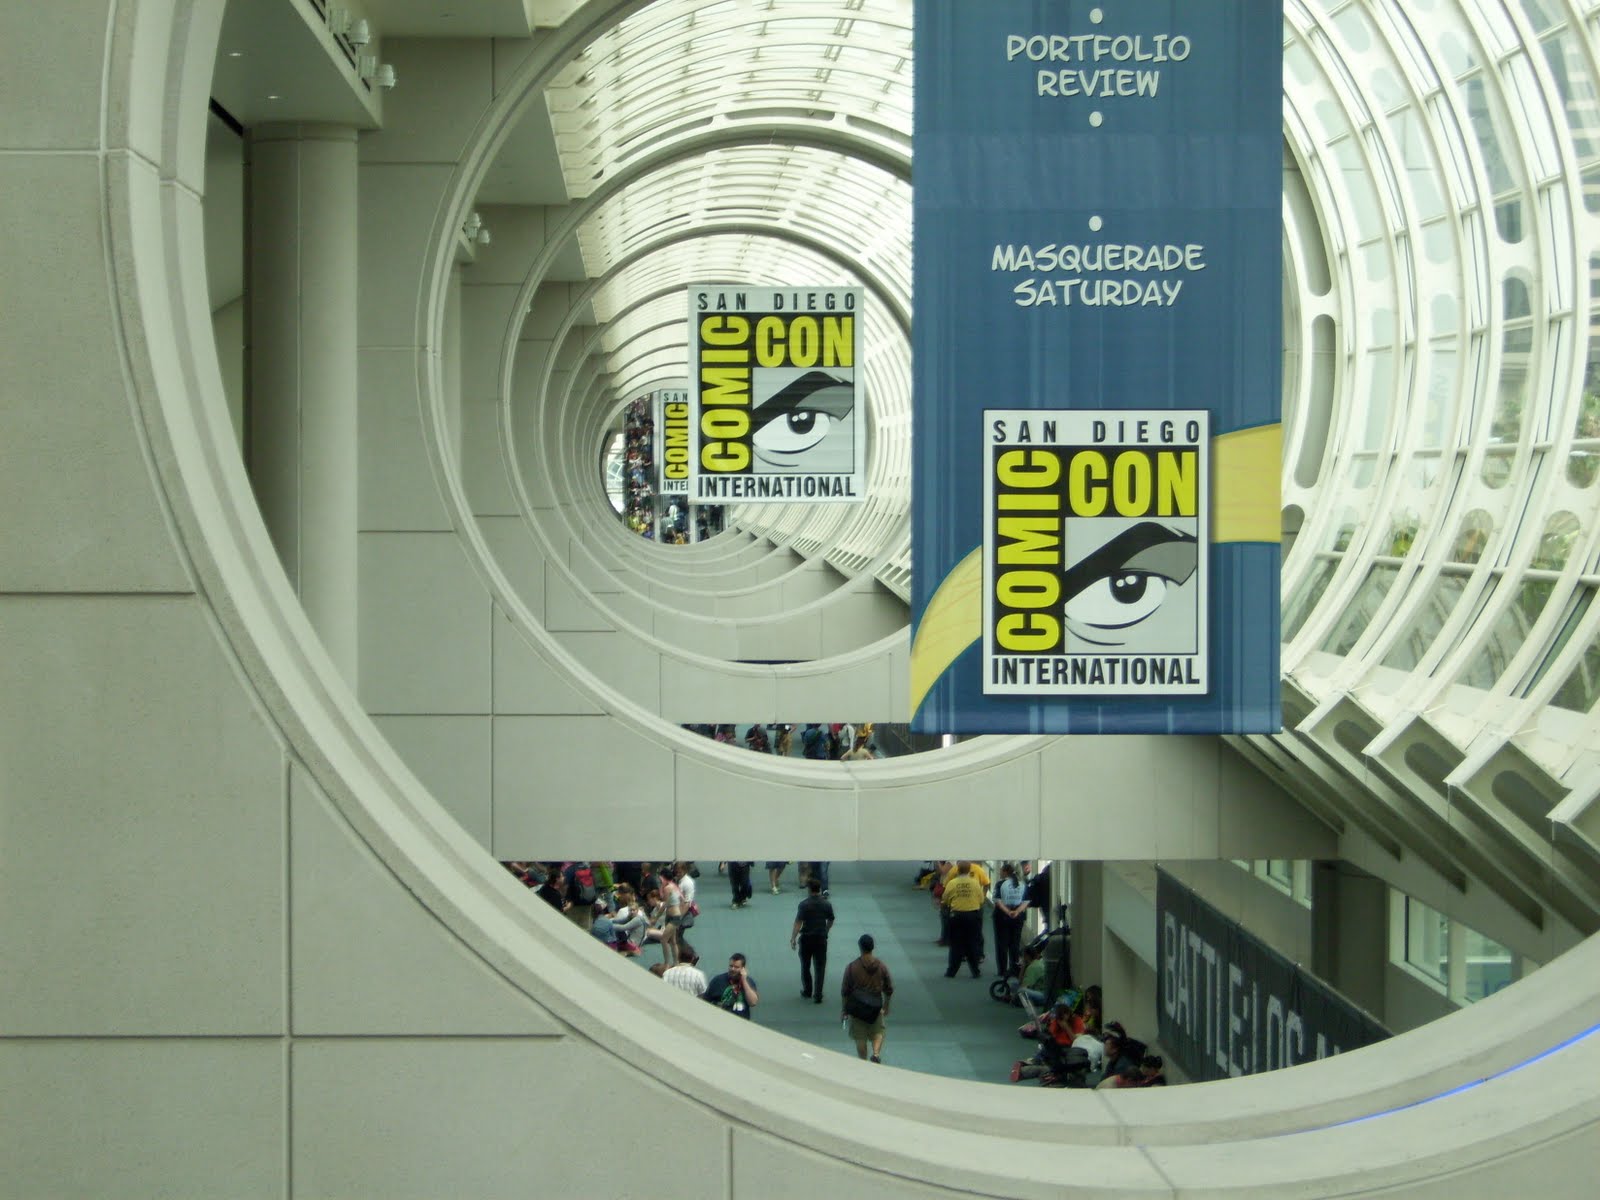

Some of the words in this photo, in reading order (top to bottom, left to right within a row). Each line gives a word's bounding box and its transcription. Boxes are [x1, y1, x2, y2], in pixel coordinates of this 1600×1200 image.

[1006, 34, 1191, 63] PORTFOLIO
[1037, 70, 1160, 98] REVIEW
[991, 244, 1206, 273] MASQUERADE
[697, 292, 747, 310] SAN
[773, 292, 856, 310] DIEGO
[1013, 278, 1183, 307] SATURDAY
[755, 315, 854, 368] CON
[664, 393, 688, 402] SAN
[701, 315, 750, 472] COMIC
[665, 403, 689, 479] COMIC
[993, 420, 1057, 443] SAN
[1092, 420, 1200, 443] DIEGO
[664, 481, 689, 491] INTE
[697, 476, 857, 498] INTERNATIONAL
[1068, 450, 1196, 517] CON
[996, 450, 1061, 651] COMIC
[992, 657, 1200, 685] INTERNATIONAL
